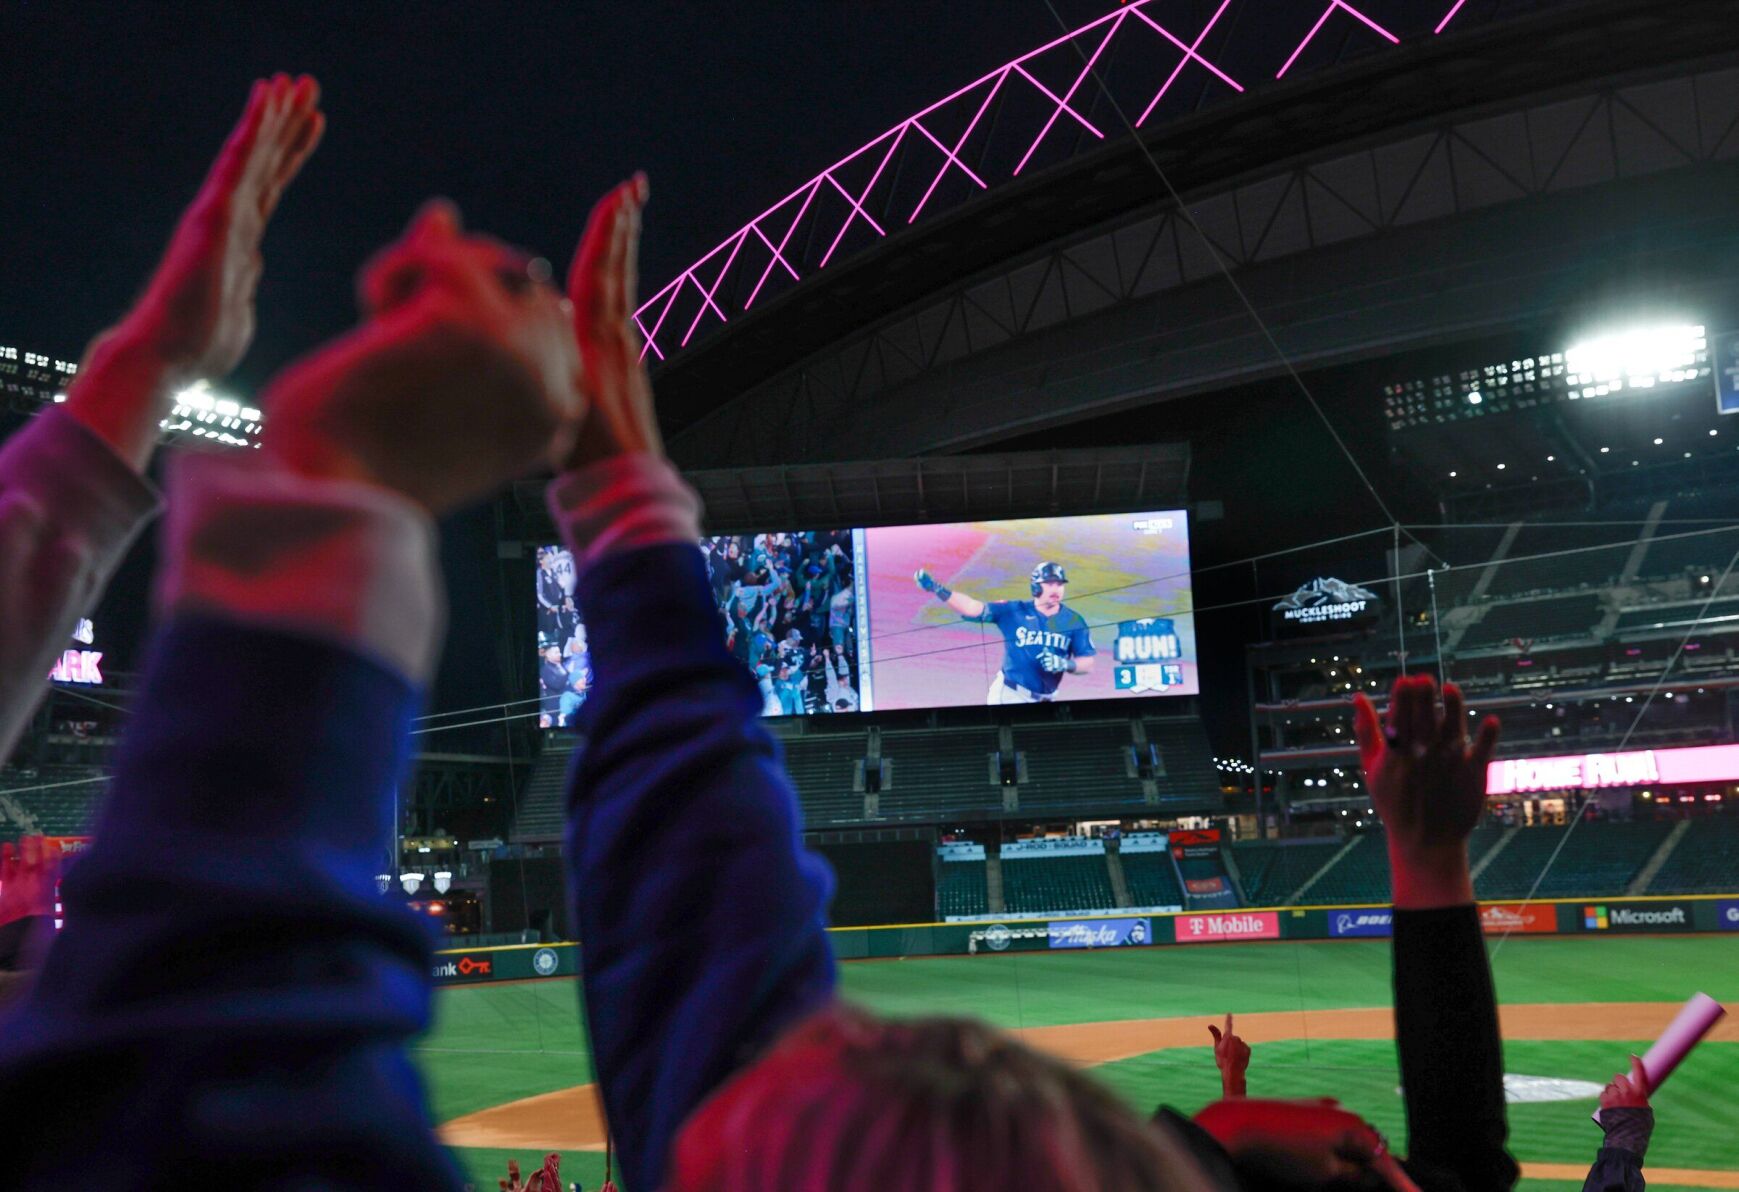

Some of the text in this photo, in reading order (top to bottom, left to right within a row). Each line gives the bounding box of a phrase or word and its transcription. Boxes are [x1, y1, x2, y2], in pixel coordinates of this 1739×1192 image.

[1284, 600, 1366, 619] MUCKLESHOOT
[1118, 634, 1177, 660] RUN!
[1120, 669, 1132, 685] 3
[1503, 759, 1583, 790] HOME
[1208, 915, 1264, 934] Mobile
[1611, 908, 1685, 925] Microsoft
